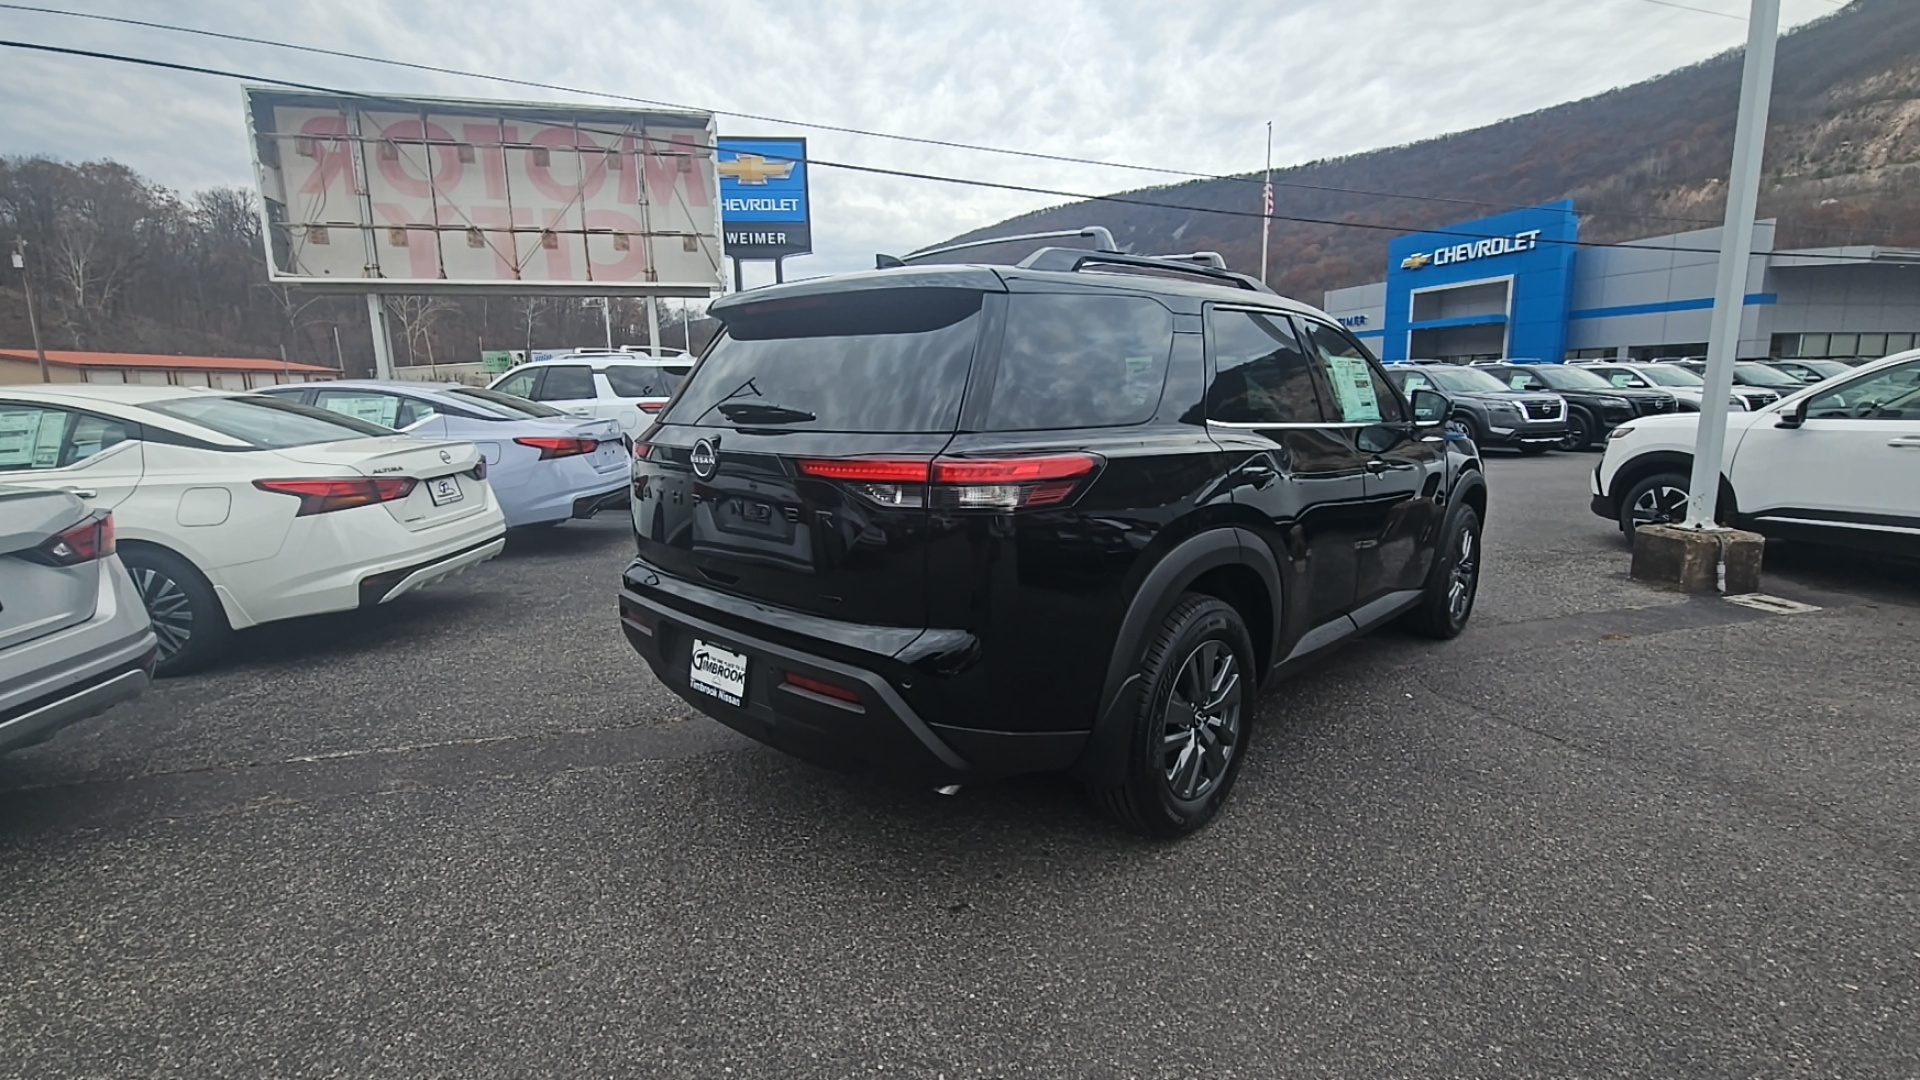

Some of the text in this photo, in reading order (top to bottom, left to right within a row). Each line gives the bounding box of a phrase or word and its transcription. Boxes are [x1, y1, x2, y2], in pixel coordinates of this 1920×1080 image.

[721, 198, 799, 211] HEVROLET
[726, 232, 787, 245] WEIMER
[1433, 229, 1541, 266] CHEVROLET
[693, 650, 746, 684] TIMBROOK
